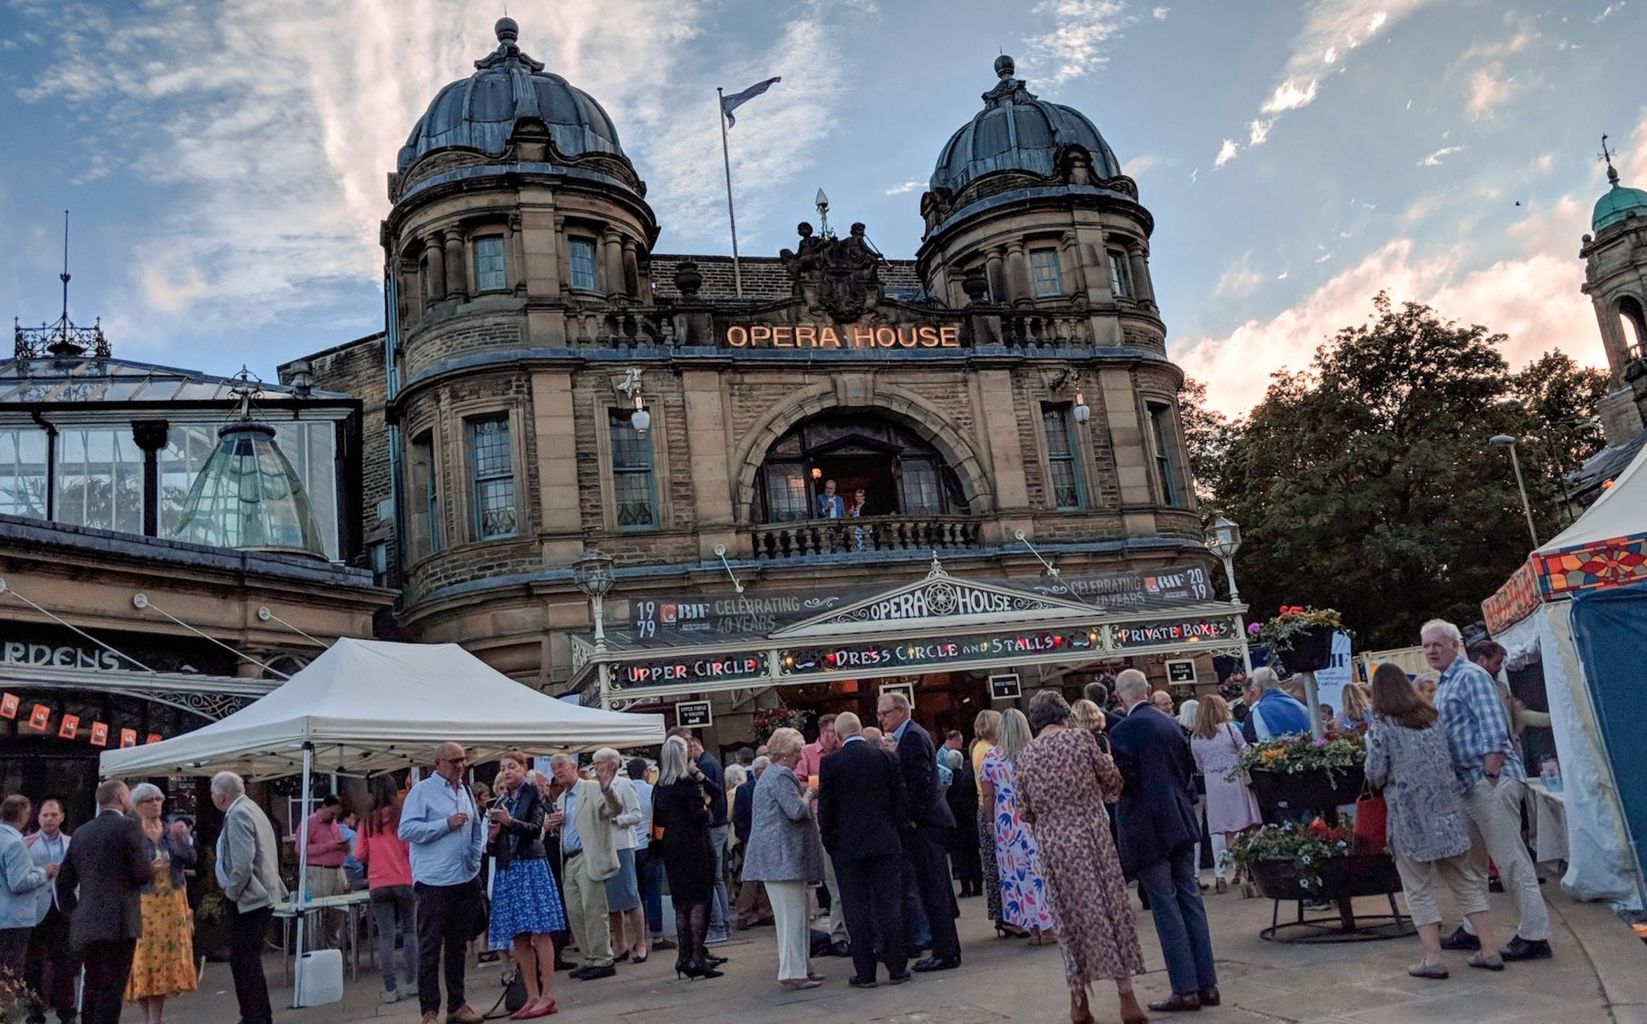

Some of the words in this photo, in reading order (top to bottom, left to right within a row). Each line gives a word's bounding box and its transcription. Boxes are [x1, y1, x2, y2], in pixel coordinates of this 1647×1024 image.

[726, 325, 841, 347] OPERA
[855, 325, 960, 347] HOUSE
[1070, 576, 1142, 595] CELEBRATING
[1187, 568, 1203, 585] 20
[1108, 592, 1146, 607] YEARS
[1191, 584, 1207, 600] 19
[637, 601, 655, 620] 19
[715, 597, 800, 616] CELEBRATING
[870, 589, 928, 620] OPERA
[956, 586, 1011, 614] HOUSE
[637, 620, 656, 638] 79
[717, 616, 733, 633] 40
[736, 614, 776, 633] YEARS
[1120, 626, 1180, 642] PRIVATE
[1183, 622, 1227, 637] BOXES
[836, 649, 891, 666] DRESS
[896, 643, 958, 661] CIRCLE
[992, 636, 1053, 654] STALLS
[628, 663, 687, 682] UPPER
[695, 659, 755, 677] CIRCLE
